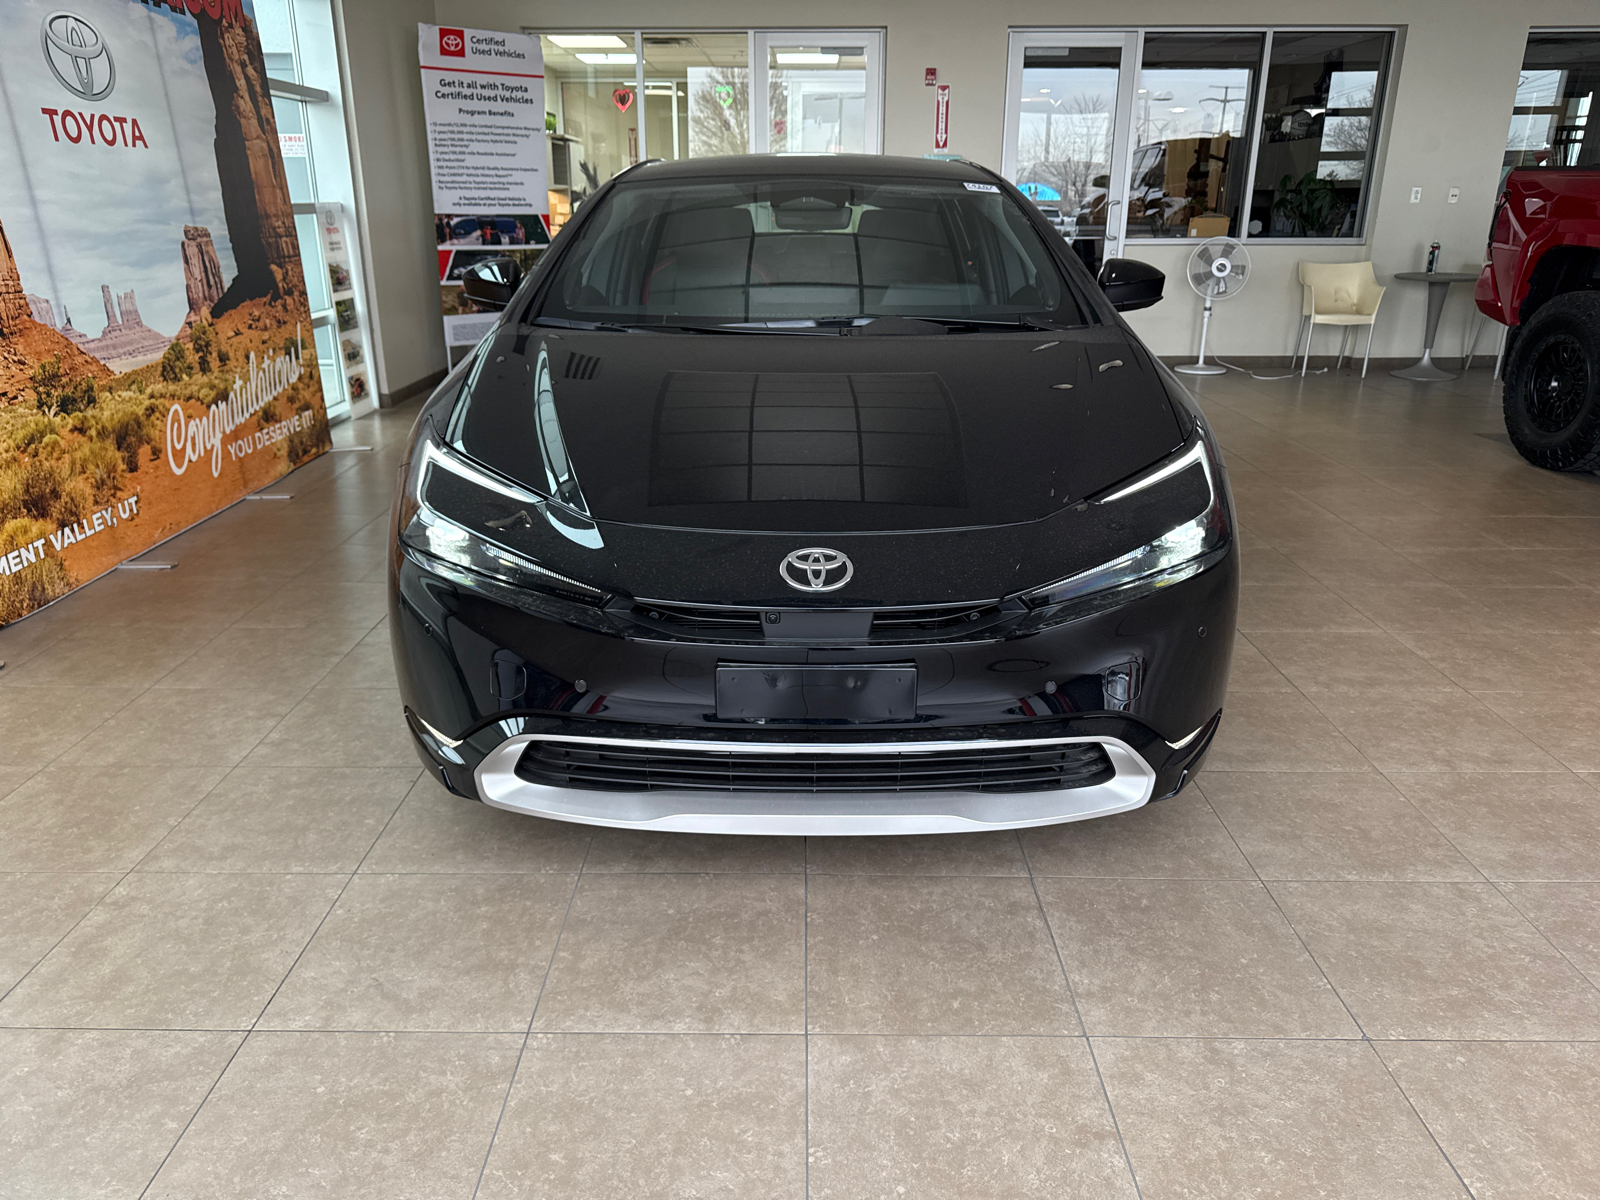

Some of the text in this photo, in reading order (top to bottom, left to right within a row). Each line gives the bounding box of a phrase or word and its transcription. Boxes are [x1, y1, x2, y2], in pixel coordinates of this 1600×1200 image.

[470, 36, 505, 46] Certified
[471, 46, 526, 59] Used Vehicles
[439, 79, 528, 93] Get it all with Toyota
[435, 90, 534, 104] Certified Used Vehicles
[458, 108, 487, 117] Program
[41, 107, 149, 149] TOYOTA
[166, 321, 305, 478] Congratulations!
[227, 409, 314, 462] YOU DESERVE IT!
[48, 507, 118, 552] VALLEY,
[118, 496, 138, 519] UT
